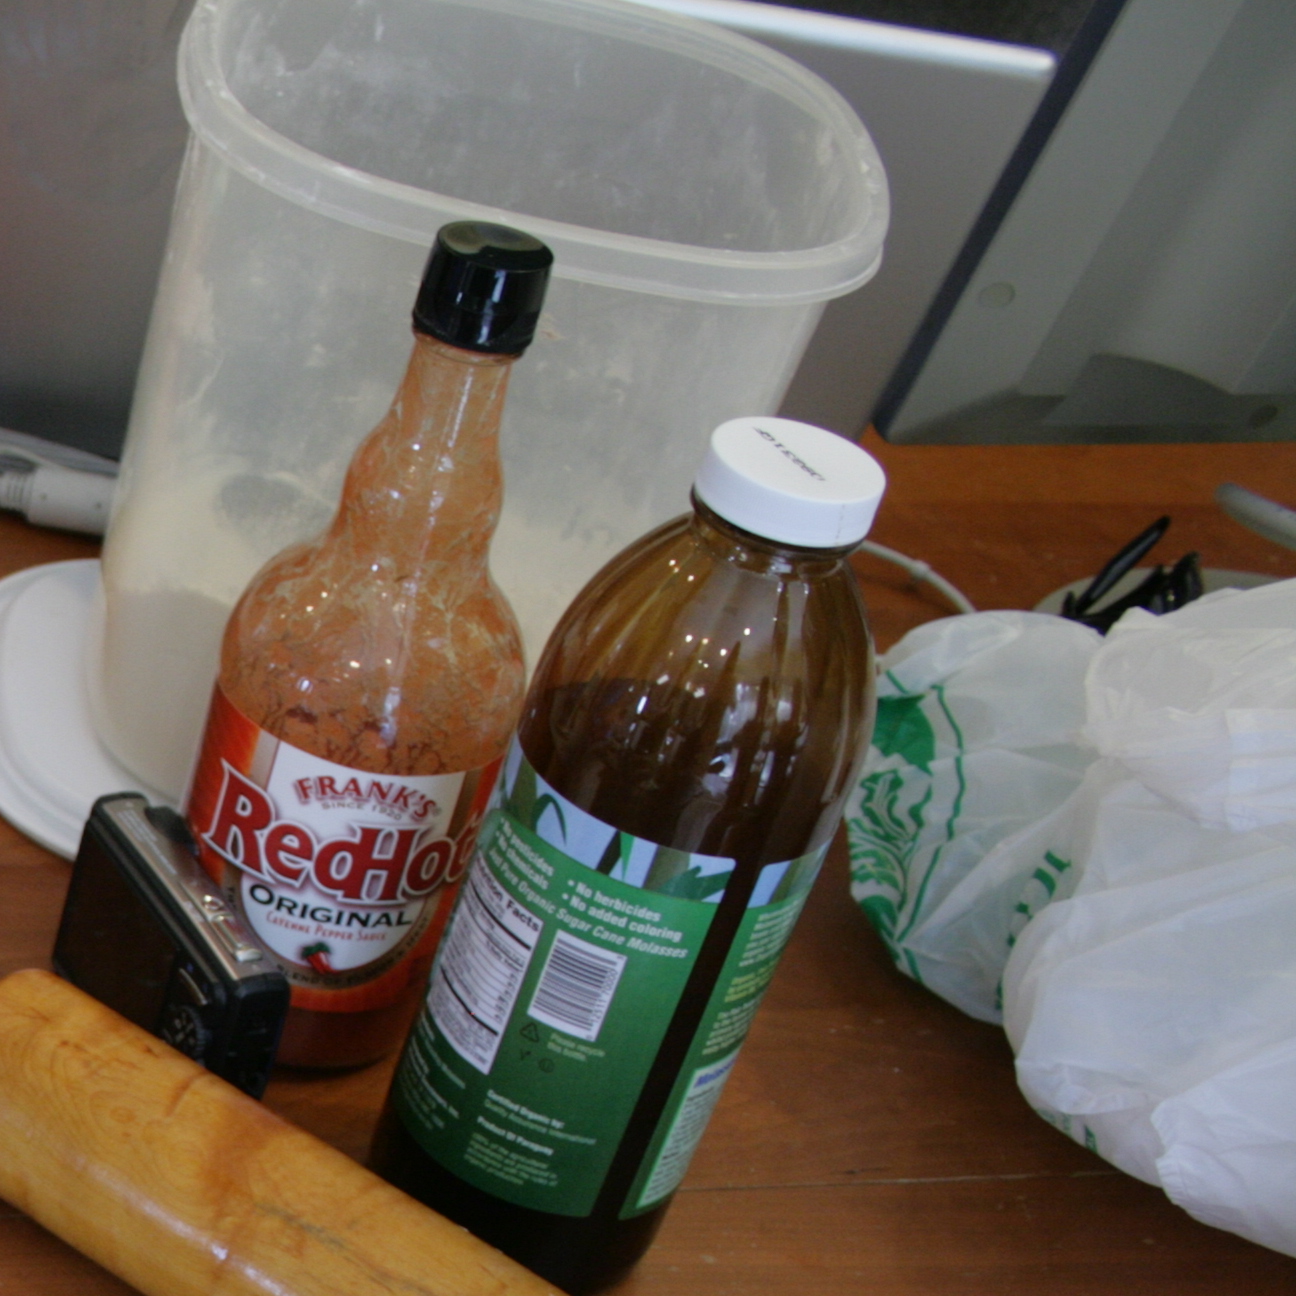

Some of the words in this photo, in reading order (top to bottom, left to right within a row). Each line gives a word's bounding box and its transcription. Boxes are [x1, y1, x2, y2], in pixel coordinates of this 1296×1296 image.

[294, 775, 436, 820] FRANK'S
[322, 801, 364, 811] SINCE
[371, 803, 402, 821] 1920
[249, 884, 412, 928] ORIGINAL
[506, 900, 540, 932] Facts
[517, 880, 556, 915] Organic
[556, 907, 592, 934] Sugar
[592, 925, 624, 947] Cane
[626, 936, 689, 959] Molasses
[569, 895, 588, 912] No
[588, 904, 628, 928] added
[629, 921, 684, 943] coloring
[575, 881, 593, 899] No
[594, 890, 661, 923] herbicides
[314, 924, 354, 941] PEPPER
